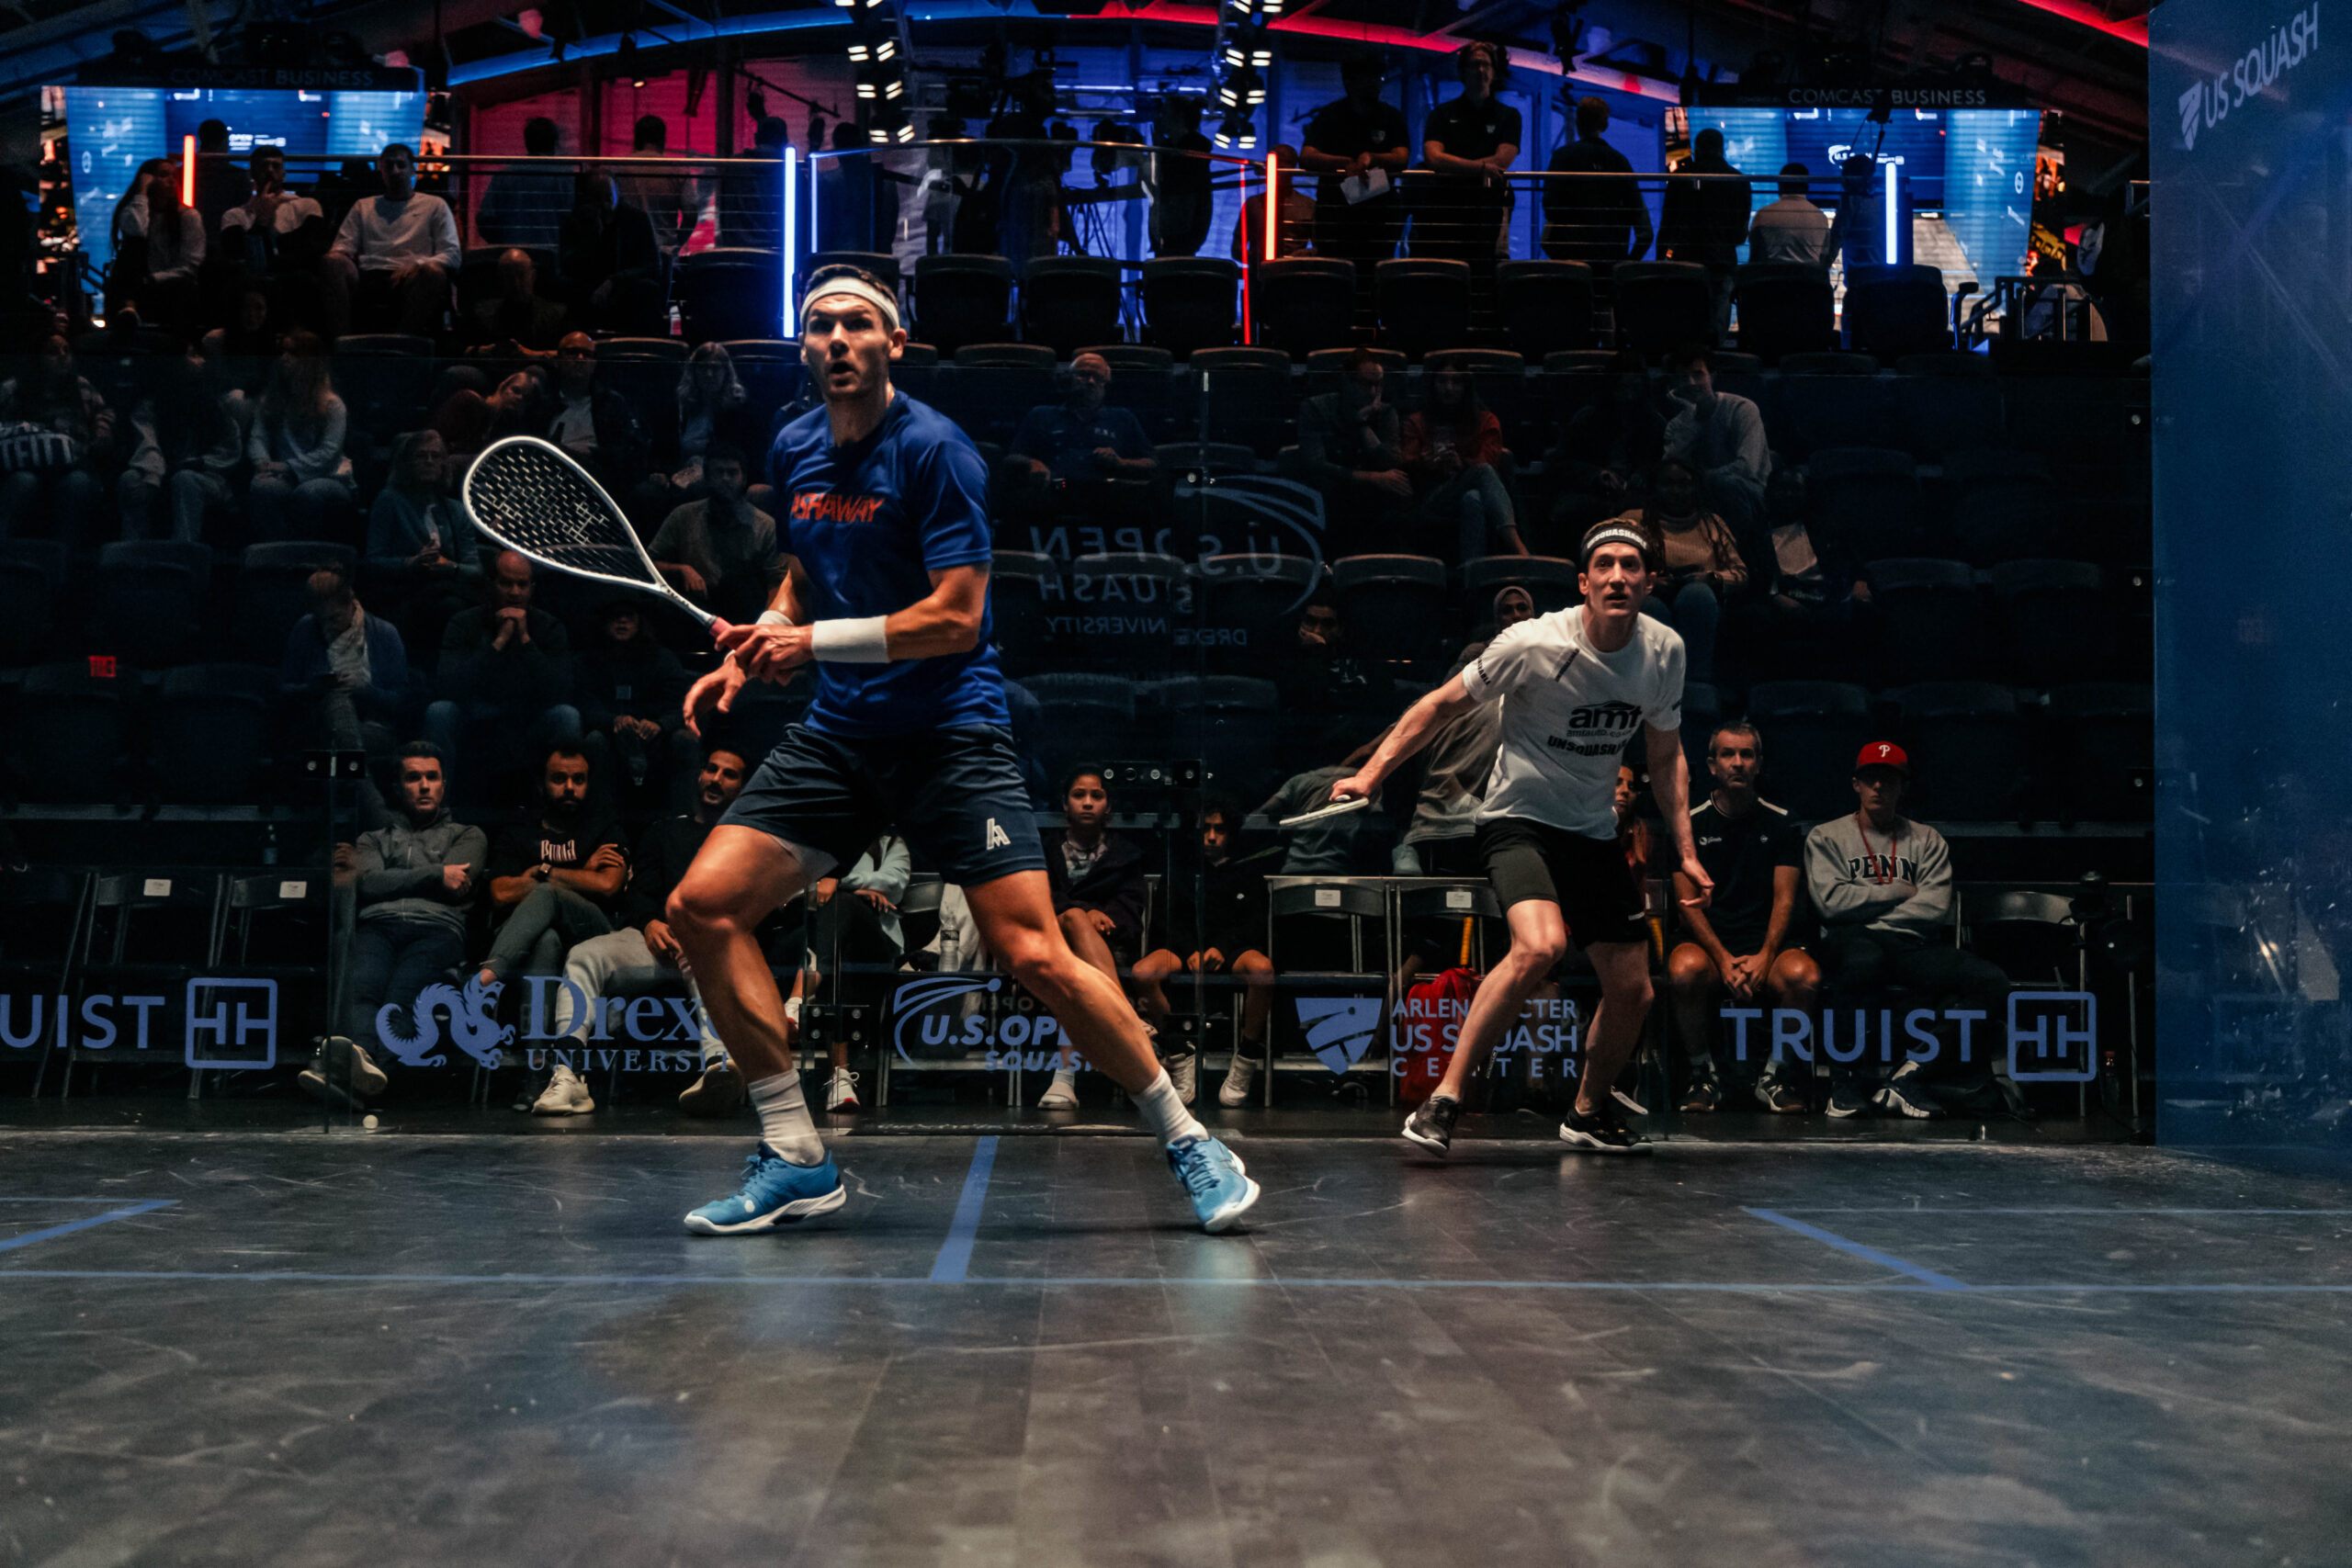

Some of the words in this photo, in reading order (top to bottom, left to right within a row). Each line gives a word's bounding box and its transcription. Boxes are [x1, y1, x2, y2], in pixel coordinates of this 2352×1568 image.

[276, 69, 374, 86] BUSINESS
[2205, 72, 2229, 129] US
[2233, 1, 2319, 107] SQUASH
[1891, 89, 1986, 106] BUSINESS
[1878, 744, 1891, 758] P
[1848, 854, 1918, 884] PENN
[0, 993, 166, 1049] UIST
[1390, 1023, 1432, 1052] US
[1442, 1023, 1578, 1053] SUASH
[1719, 1008, 1987, 1064] TRUIST
[526, 1048, 729, 1073] UNIVERSIT
[1391, 1057, 1578, 1078] CETER
